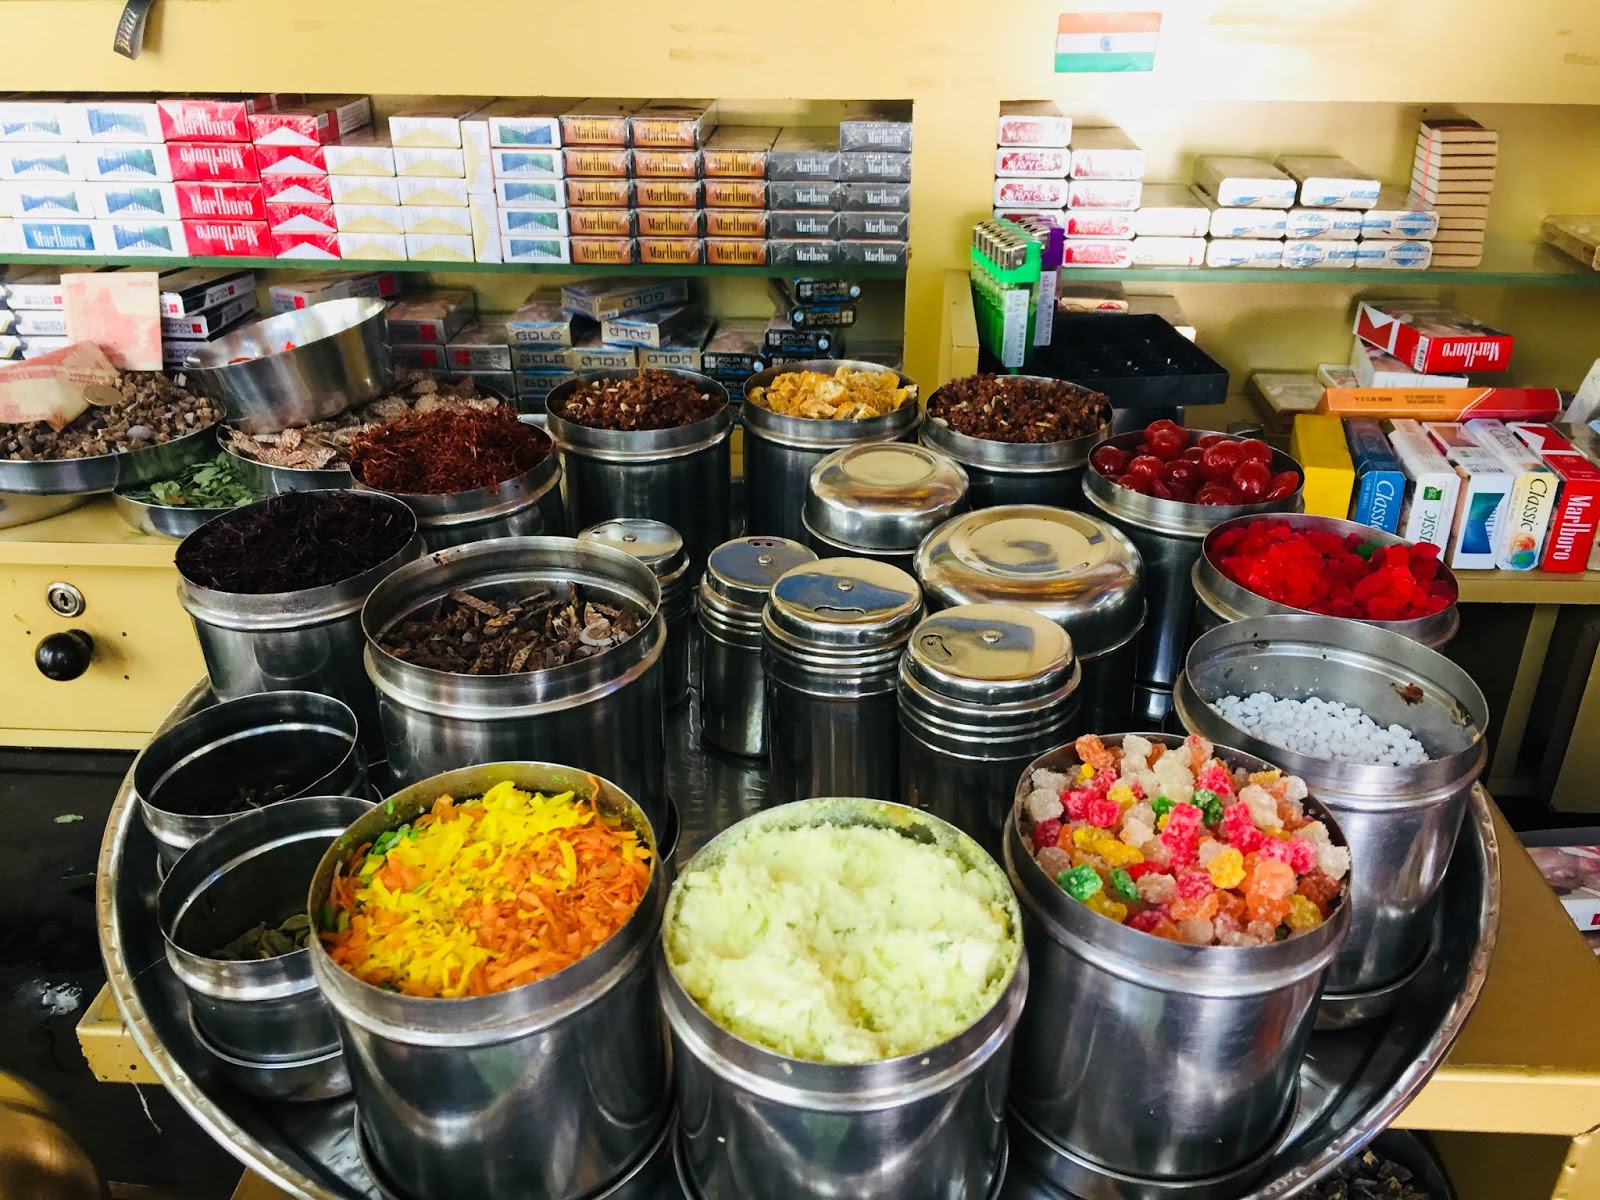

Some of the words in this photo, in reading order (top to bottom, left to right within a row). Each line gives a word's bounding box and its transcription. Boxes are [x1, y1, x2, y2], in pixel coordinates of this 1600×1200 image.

[176, 111, 236, 136] Marlboro
[180, 148, 244, 175] Marlboro
[796, 158, 830, 172] Marlboro
[868, 159, 902, 174] Marlboro
[578, 181, 620, 201] Marlboro
[646, 181, 689, 201] Marlboro
[715, 182, 757, 201] Marlboro
[796, 188, 830, 203] Marlboro
[867, 189, 900, 204] Marlboro
[189, 189, 254, 215] Marlboro
[580, 210, 622, 230] Marlboro
[648, 210, 690, 231] Marlboro
[715, 210, 758, 230] Marlboro
[796, 217, 829, 232] Marlboro
[865, 218, 899, 233] Marlboro
[33, 226, 86, 249] Marlboro
[196, 223, 259, 251] Marlboro
[581, 239, 623, 259] Marlboro
[649, 239, 691, 260] Marlboro
[716, 240, 758, 260] Marlboro
[796, 246, 829, 262] Marlboro
[864, 247, 898, 263] Marlboro
[622, 291, 665, 309] GOLD
[515, 330, 562, 342] GOLD
[608, 327, 651, 341] GOLD
[519, 354, 565, 365] GOLD
[580, 355, 627, 367] GOLD
[646, 353, 693, 365] GOLD
[1441, 341, 1501, 368] Marlboro
[524, 378, 558, 389] GOL
[1521, 478, 1548, 532] Classic
[1553, 495, 1593, 561] Marlboro
